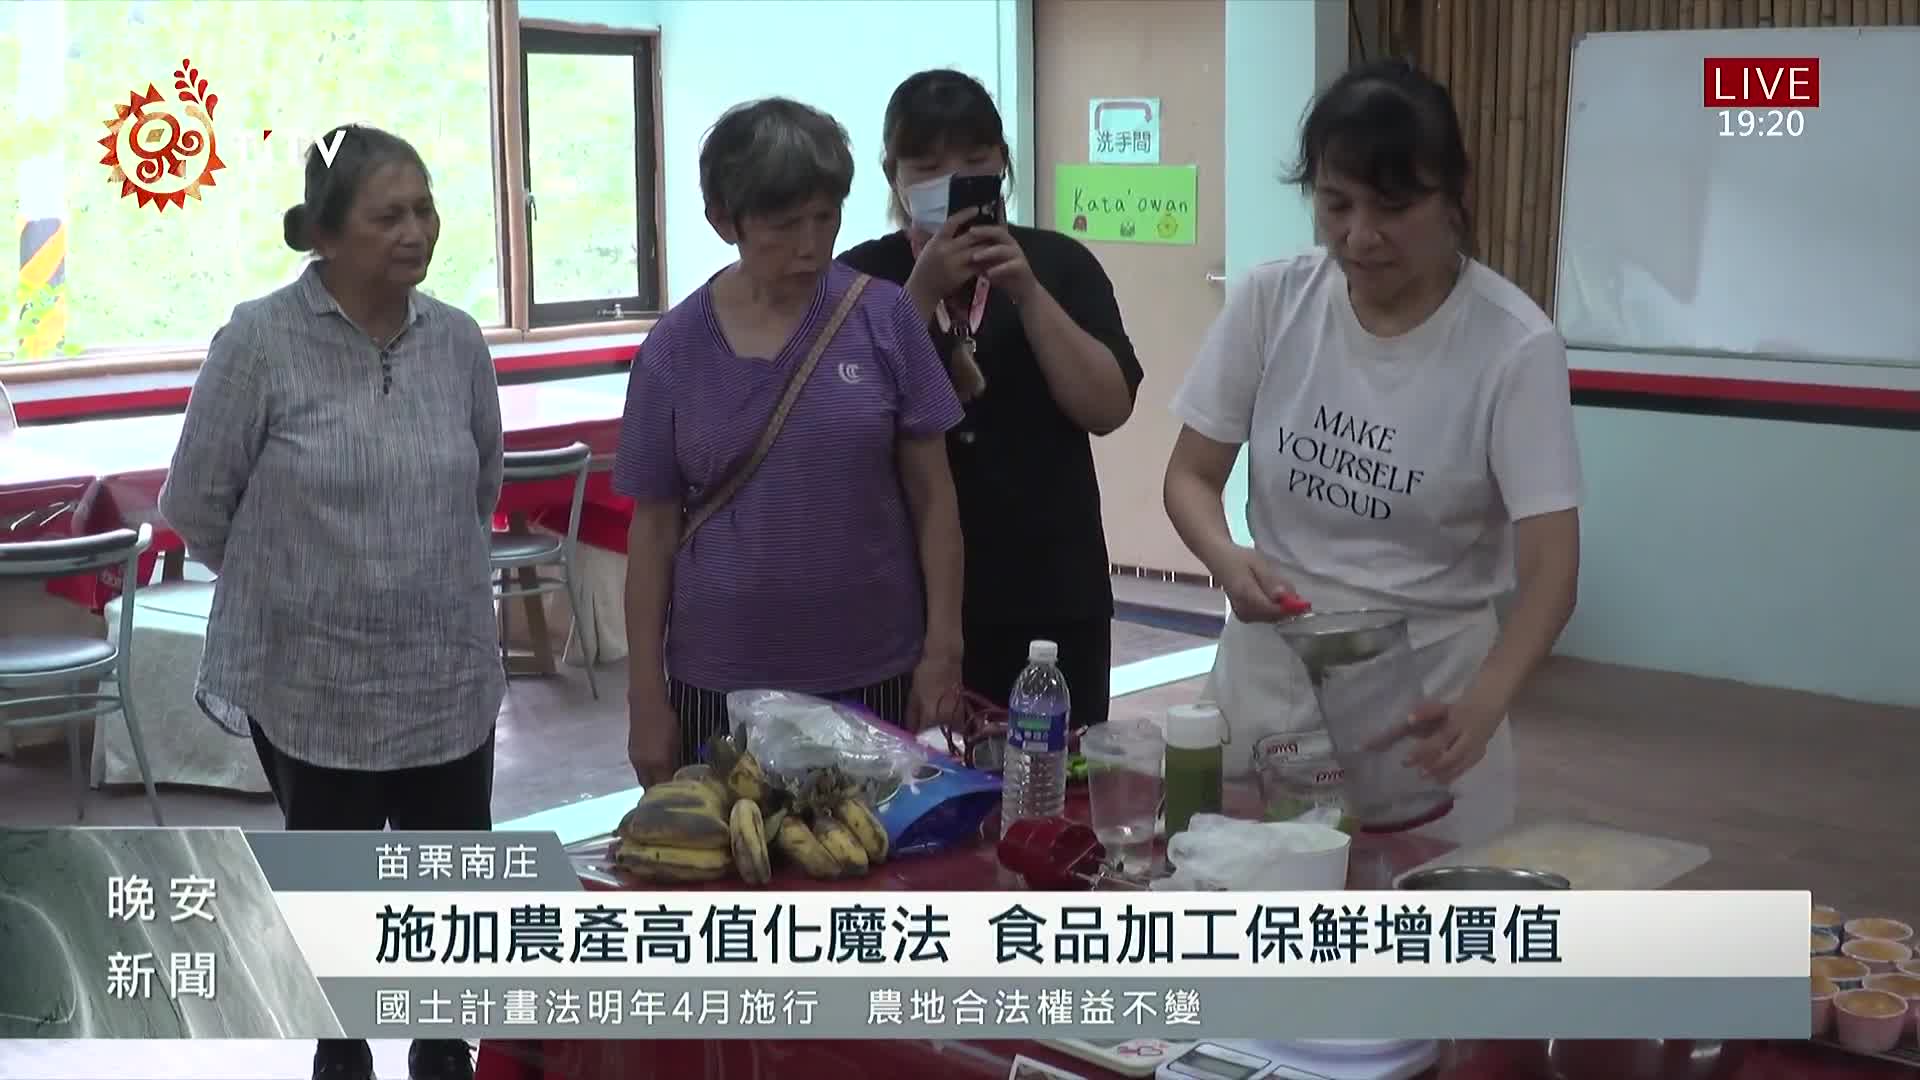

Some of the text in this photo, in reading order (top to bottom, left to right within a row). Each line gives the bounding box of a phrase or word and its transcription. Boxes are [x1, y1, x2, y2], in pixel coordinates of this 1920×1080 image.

[1096, 130, 1151, 153] 洗手間
[1314, 404, 1396, 453] MAKE
[1278, 426, 1424, 496] YOURSELF
[1288, 468, 1391, 520] PROUD
